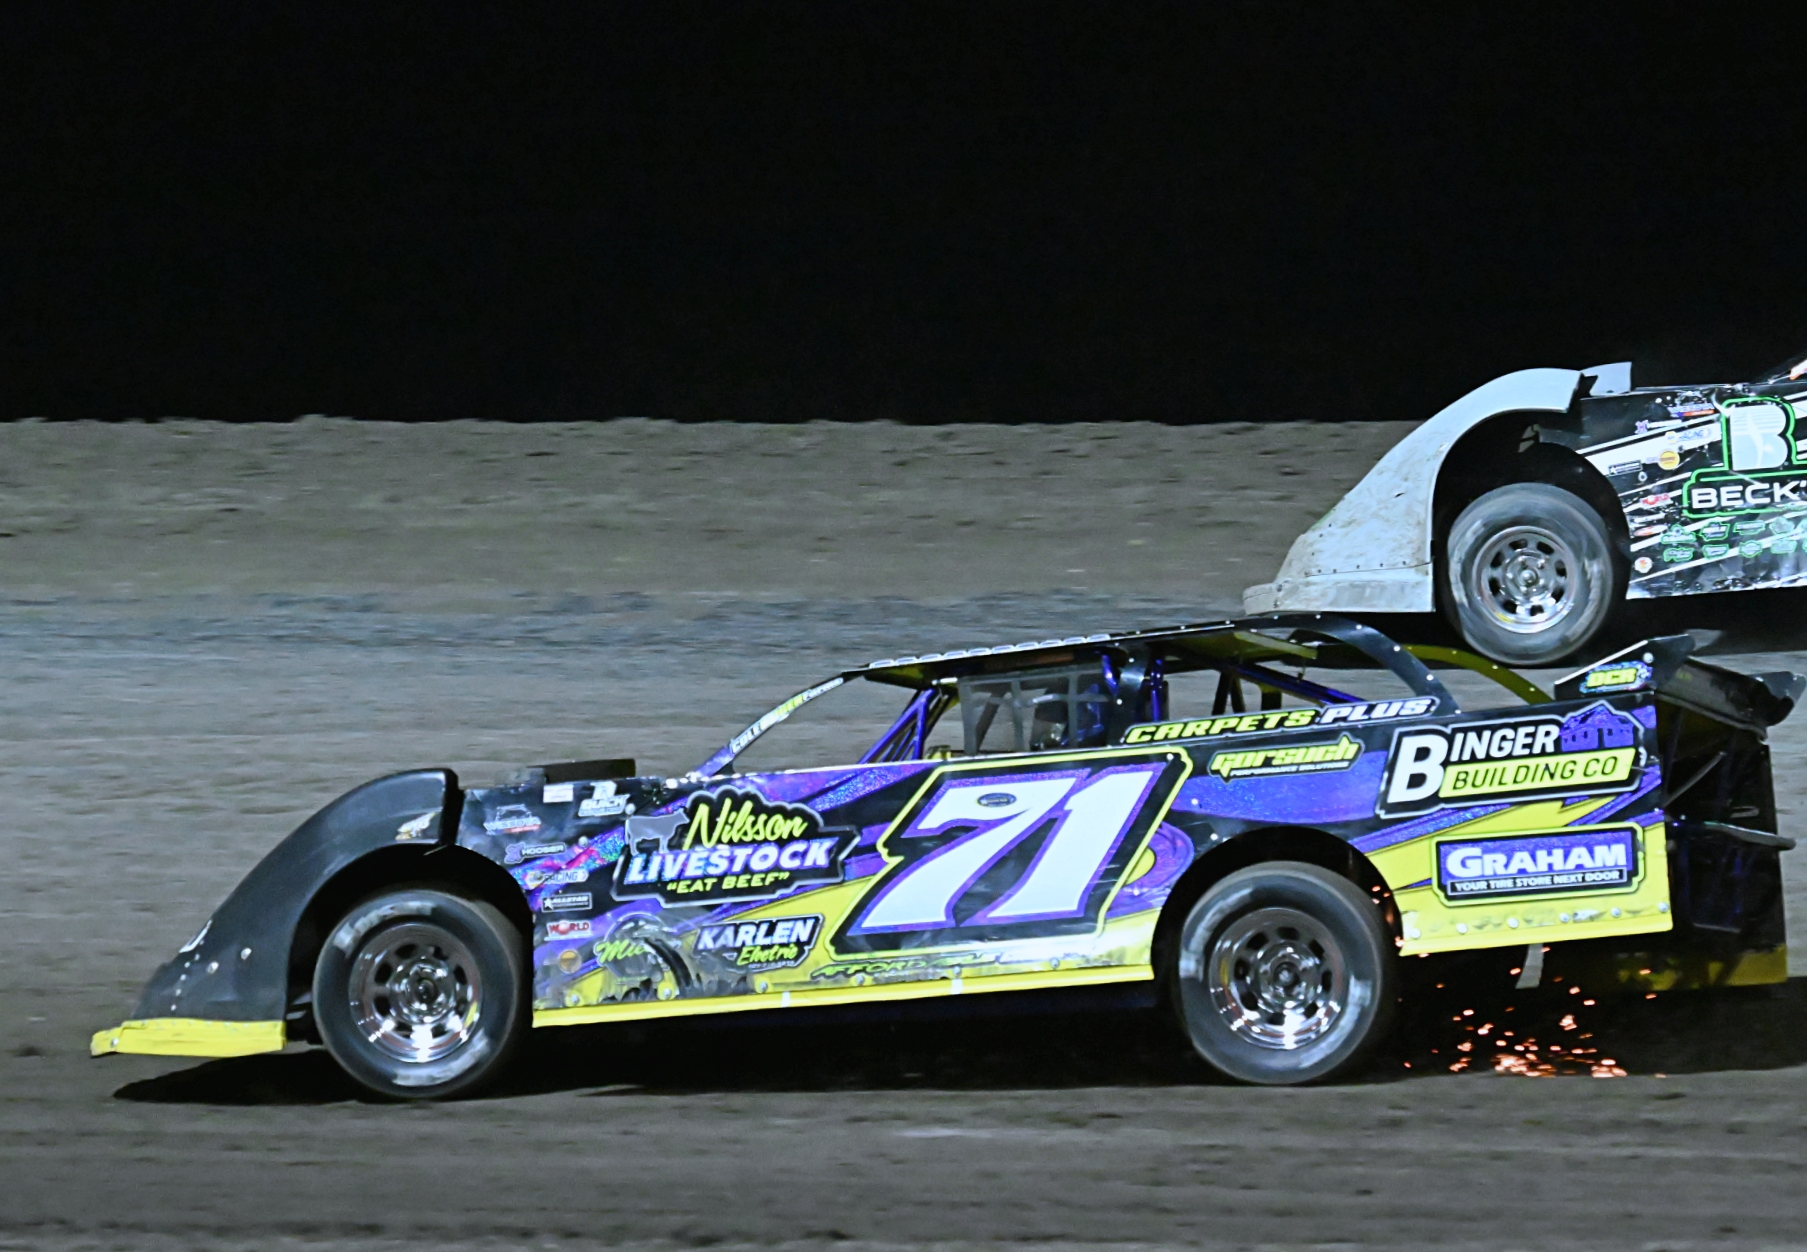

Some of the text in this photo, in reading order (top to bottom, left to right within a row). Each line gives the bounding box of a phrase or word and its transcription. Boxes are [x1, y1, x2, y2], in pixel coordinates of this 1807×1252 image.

[1126, 698, 1431, 744] CARPETS PLUS
[1387, 724, 1560, 803] BINGER
[1452, 756, 1619, 791] BUILDING CO
[682, 797, 808, 851] Nilsson
[521, 845, 564, 856] HOOSIER
[623, 838, 839, 885] LIVESTOCK
[857, 768, 1158, 930] 71
[1446, 843, 1627, 878] GRAHAM
[1455, 871, 1620, 891] YOUR TIRE STORE NEXT DOOR
[549, 922, 590, 935] WORLD
[697, 918, 816, 951] KARLEN
